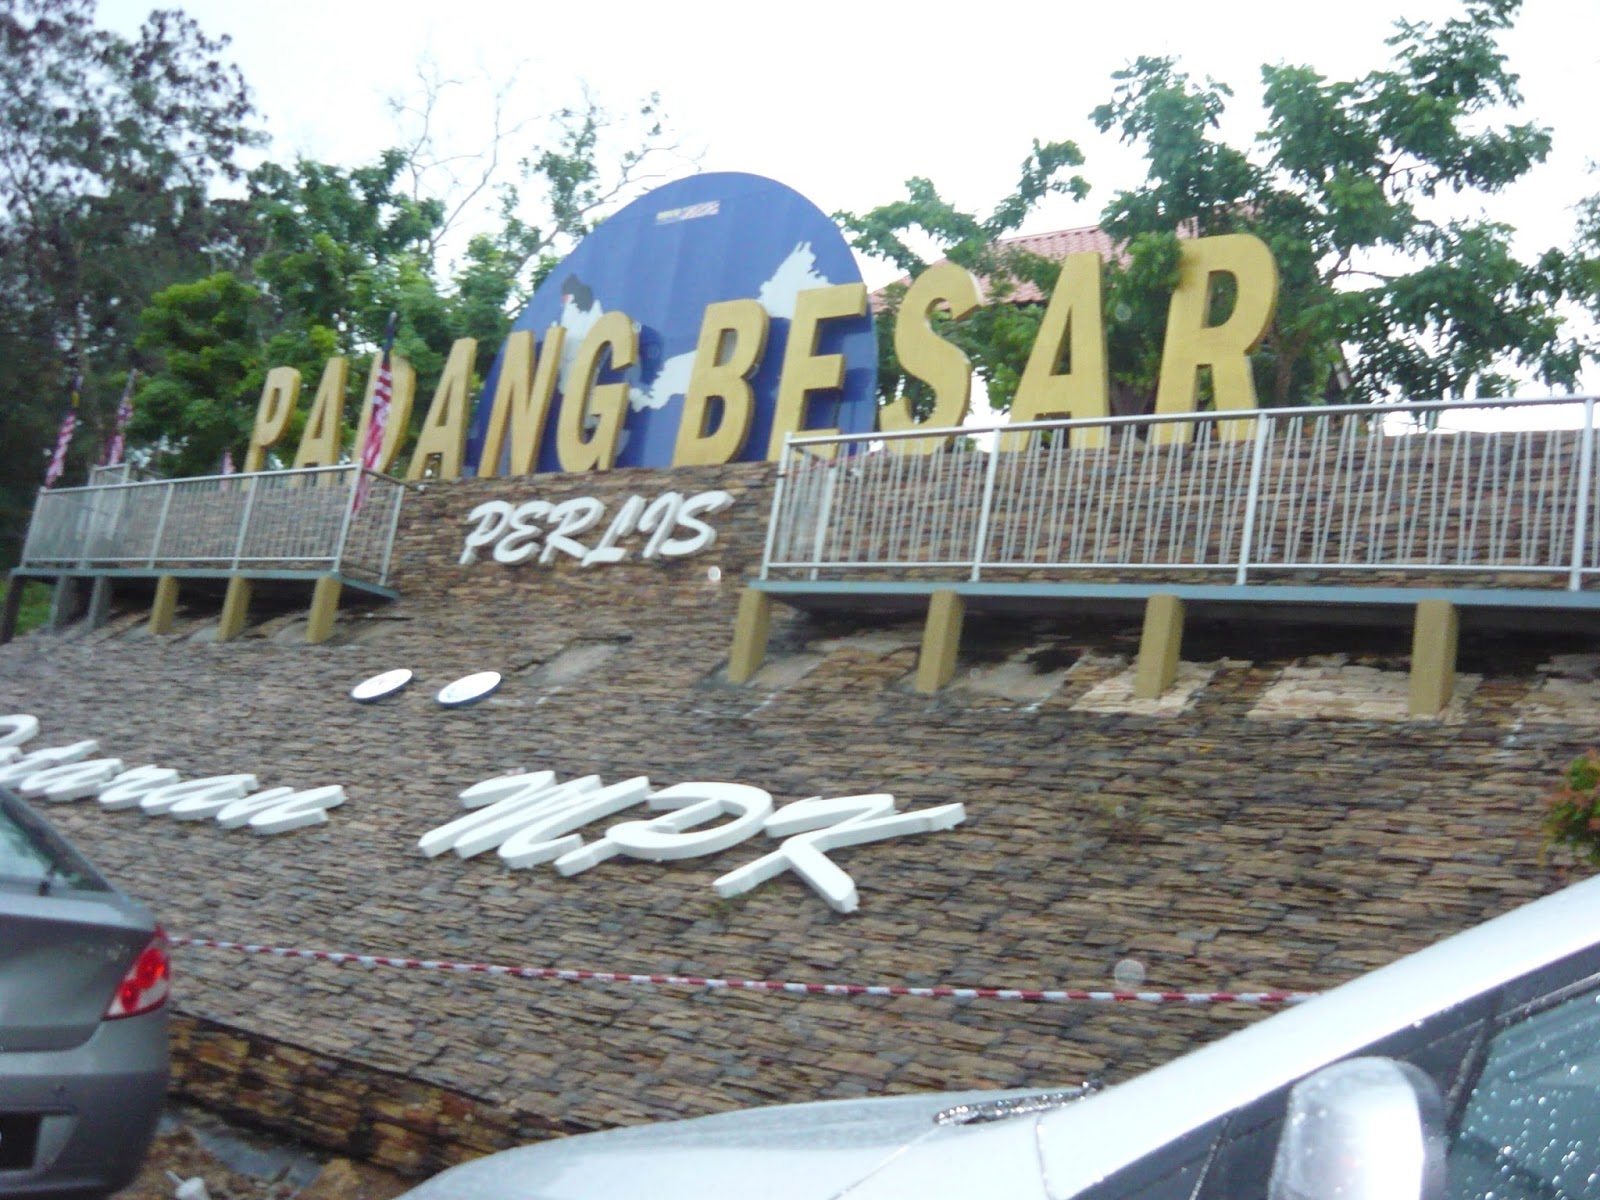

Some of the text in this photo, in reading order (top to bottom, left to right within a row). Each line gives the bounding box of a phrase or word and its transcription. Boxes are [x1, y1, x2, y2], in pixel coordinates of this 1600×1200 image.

[241, 233, 1280, 488] PADANG BESAR
[458, 489, 734, 567] PERLIS
